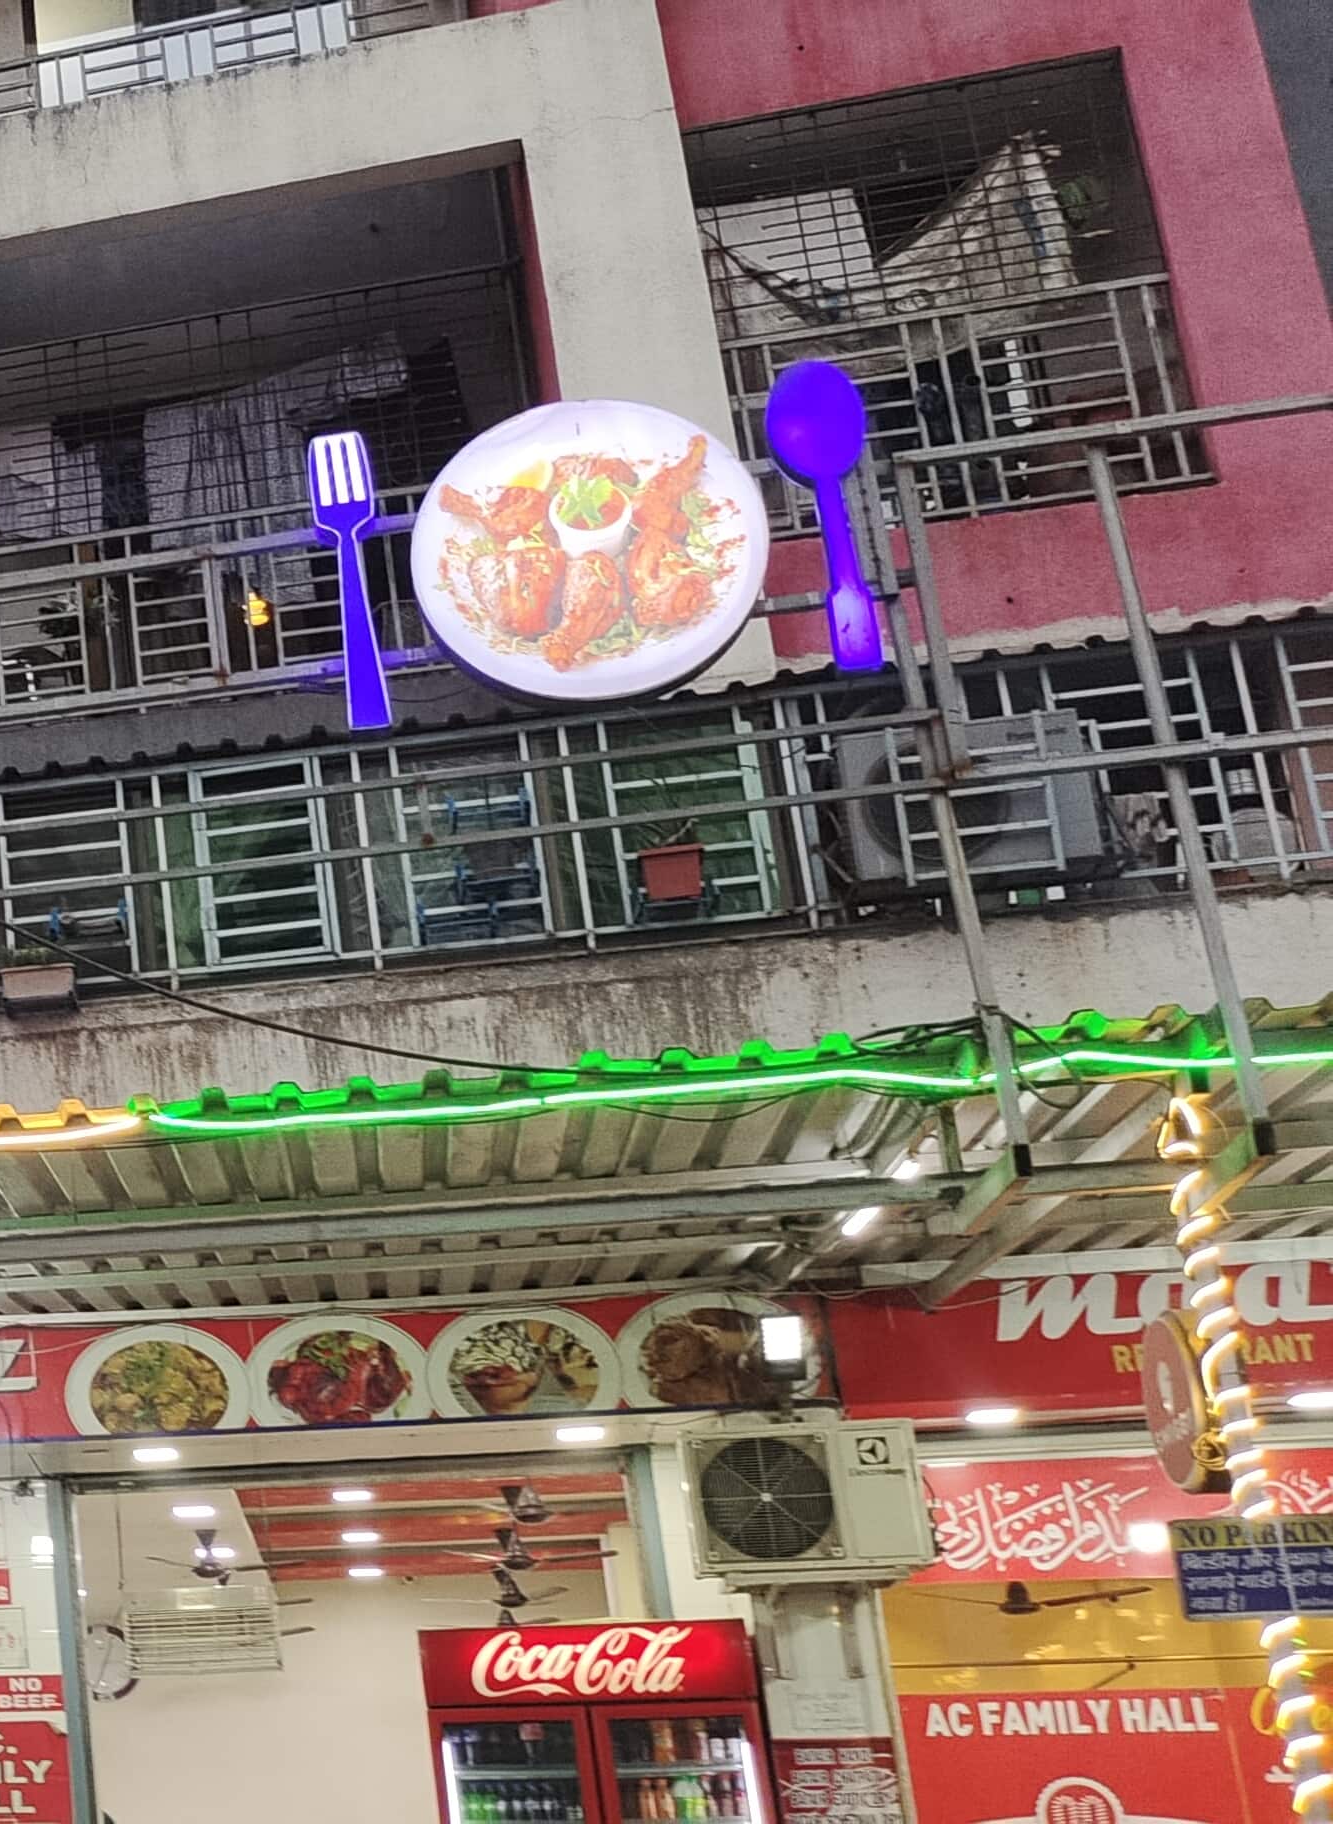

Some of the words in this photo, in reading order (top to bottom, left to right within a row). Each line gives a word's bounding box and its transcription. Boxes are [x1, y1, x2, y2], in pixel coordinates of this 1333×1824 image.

[1180, 1525, 1216, 1547] NO
[471, 1626, 693, 1697] Coca-Cola
[8, 1677, 43, 1693] NO
[925, 1702, 974, 1737] AC
[978, 1699, 1111, 1735] FAMILY
[1119, 1696, 1219, 1733] HALL
